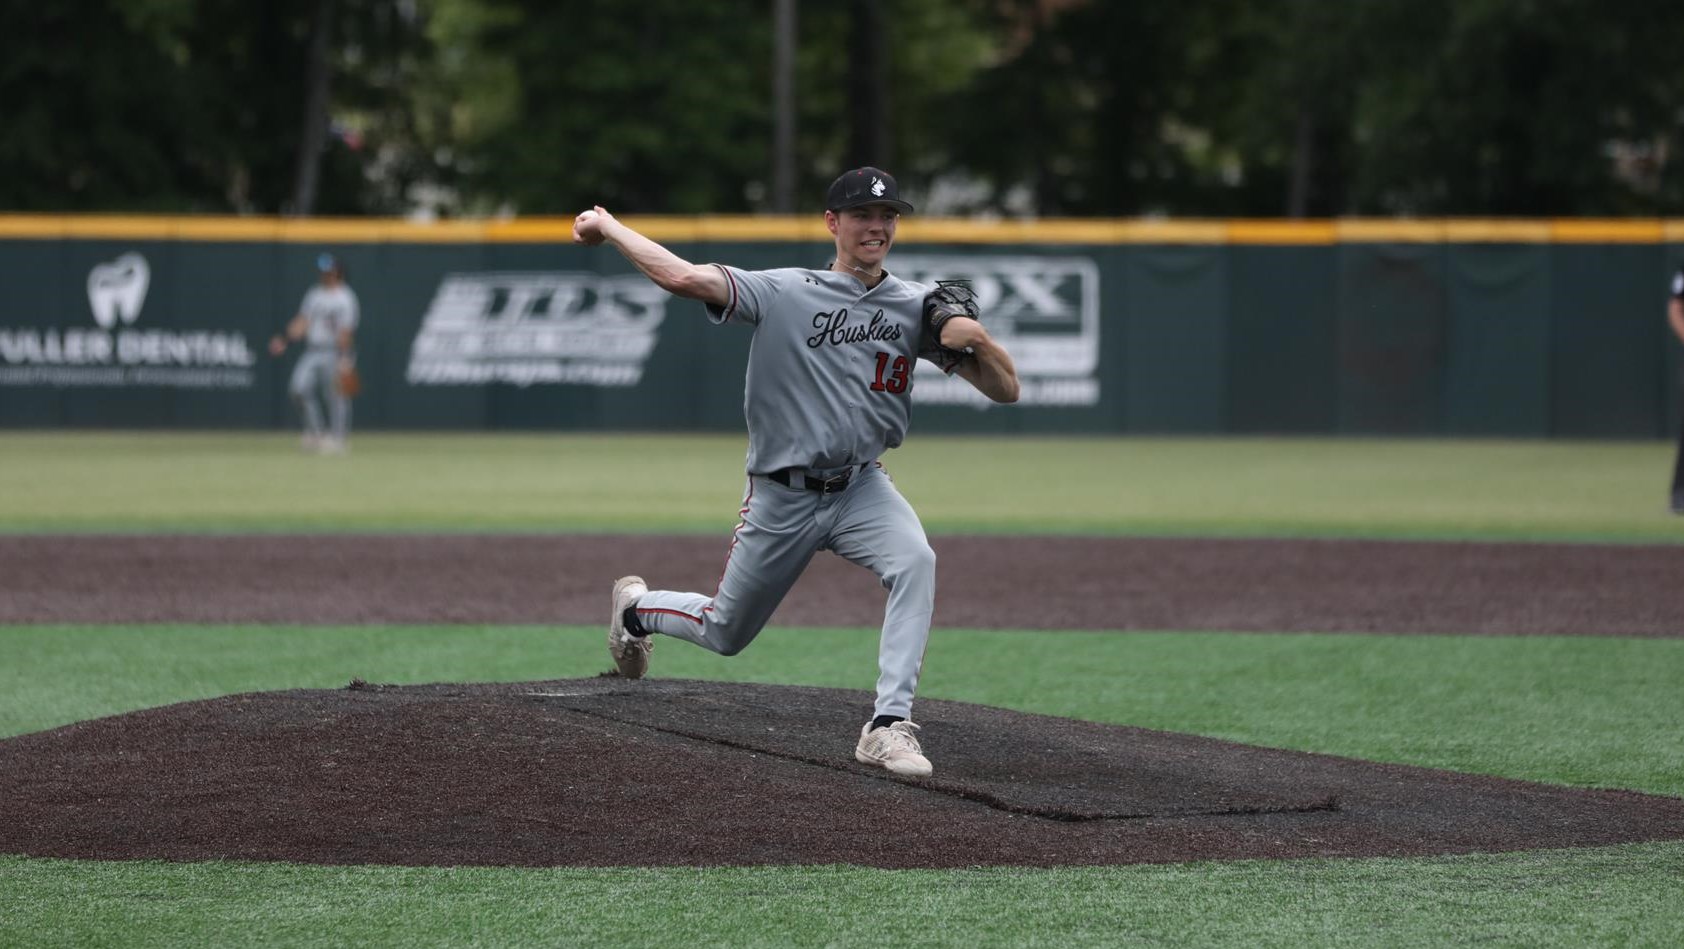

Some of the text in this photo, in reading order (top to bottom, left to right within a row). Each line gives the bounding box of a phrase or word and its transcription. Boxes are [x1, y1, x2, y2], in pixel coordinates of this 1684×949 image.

[0, 329, 255, 366] ULLER DENTAL
[807, 308, 902, 348] Huskies
[869, 351, 909, 395] 13
